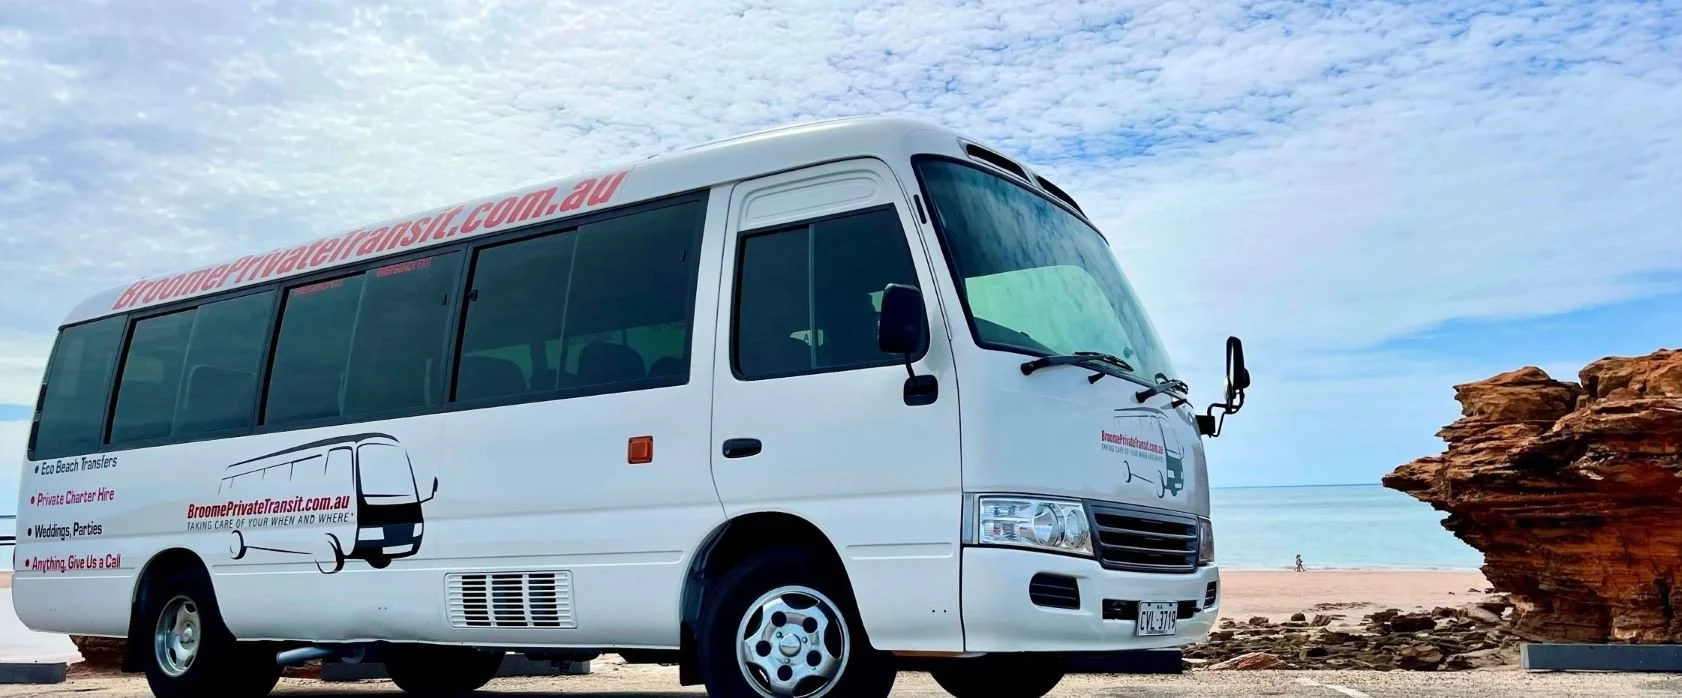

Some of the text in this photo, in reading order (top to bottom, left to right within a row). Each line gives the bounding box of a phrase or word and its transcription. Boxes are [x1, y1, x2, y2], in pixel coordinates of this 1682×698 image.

[112, 170, 630, 311] BroomePrivateTransit.com.au
[41, 455, 118, 475] Eco Beach Transfers
[37, 487, 115, 507] Private Charter Hire
[187, 495, 350, 519] BroomePrivateTransit.com.au
[34, 520, 103, 541] Weddings, Parties
[187, 520, 212, 531] TAKING
[214, 519, 233, 530] CARE
[235, 518, 245, 529] OF
[248, 517, 268, 528] YOUR
[271, 515, 295, 527] WHEN
[297, 514, 315, 525] AND
[32, 552, 121, 573] Anything, Give Us a Call
